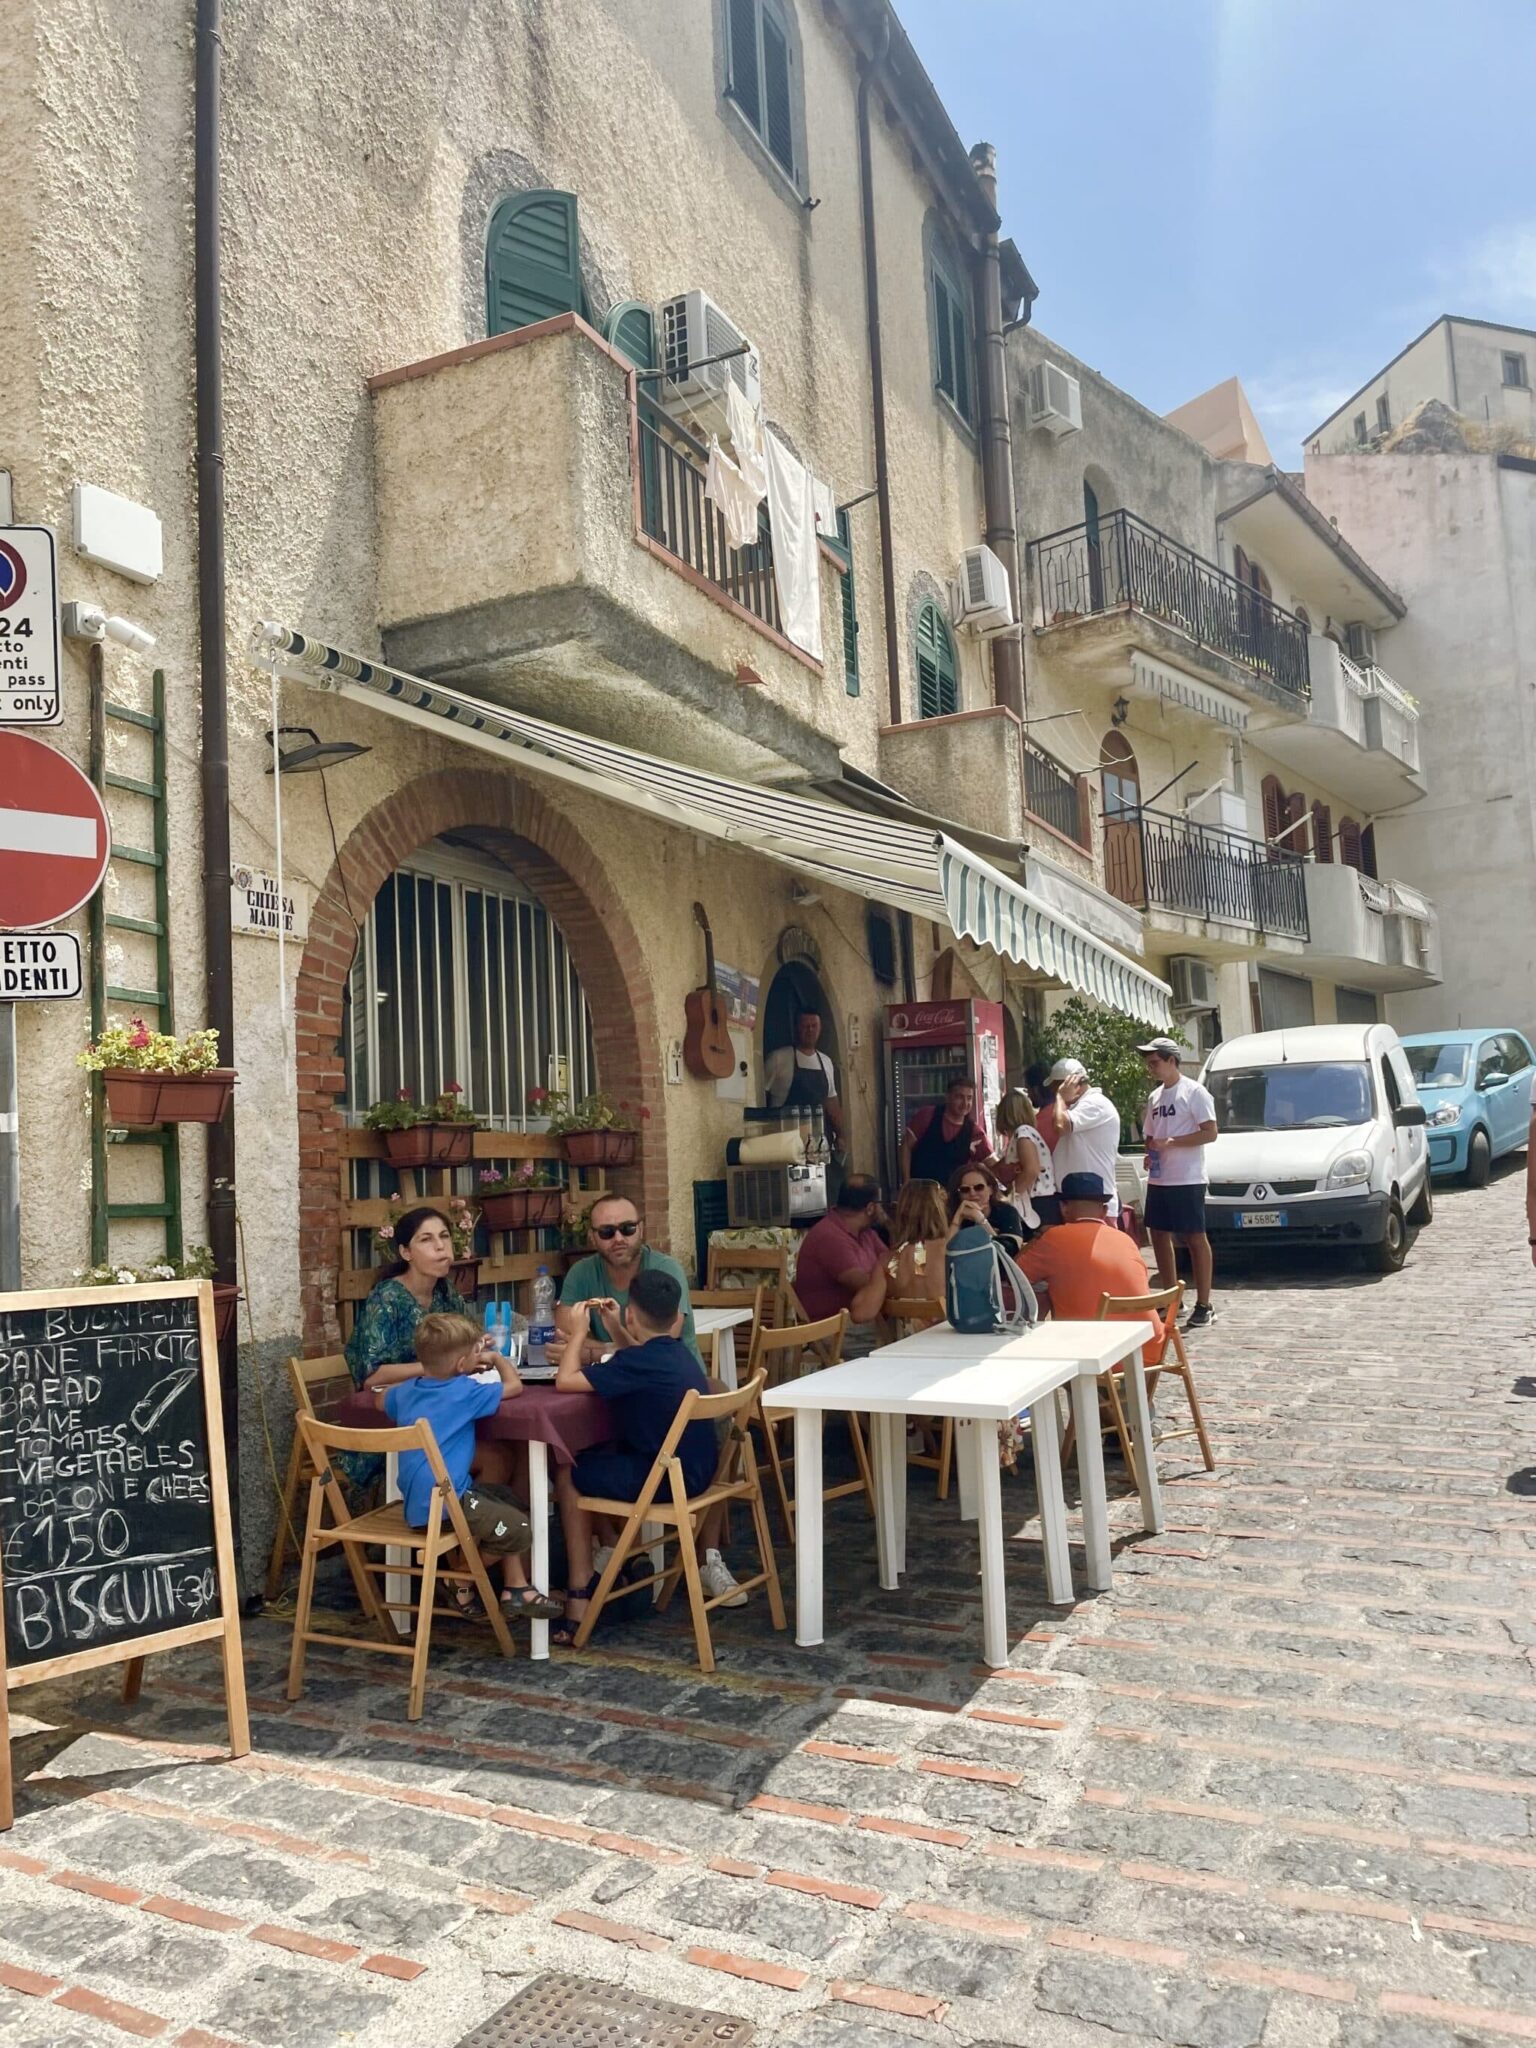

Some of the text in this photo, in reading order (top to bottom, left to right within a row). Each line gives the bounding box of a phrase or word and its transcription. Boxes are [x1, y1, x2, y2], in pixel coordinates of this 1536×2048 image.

[0, 657, 28, 669] nti
[8, 675, 45, 688] pass
[13, 695, 54, 715] only
[4, 941, 56, 963] ETTO
[0, 968, 68, 991] DENTI
[1152, 1103, 1176, 1120] FILA
[0, 1344, 81, 1383] PANE
[0, 1375, 101, 1418] BREAD
[124, 1477, 139, 1500] E
[17, 1562, 186, 1650] BISCUIT
